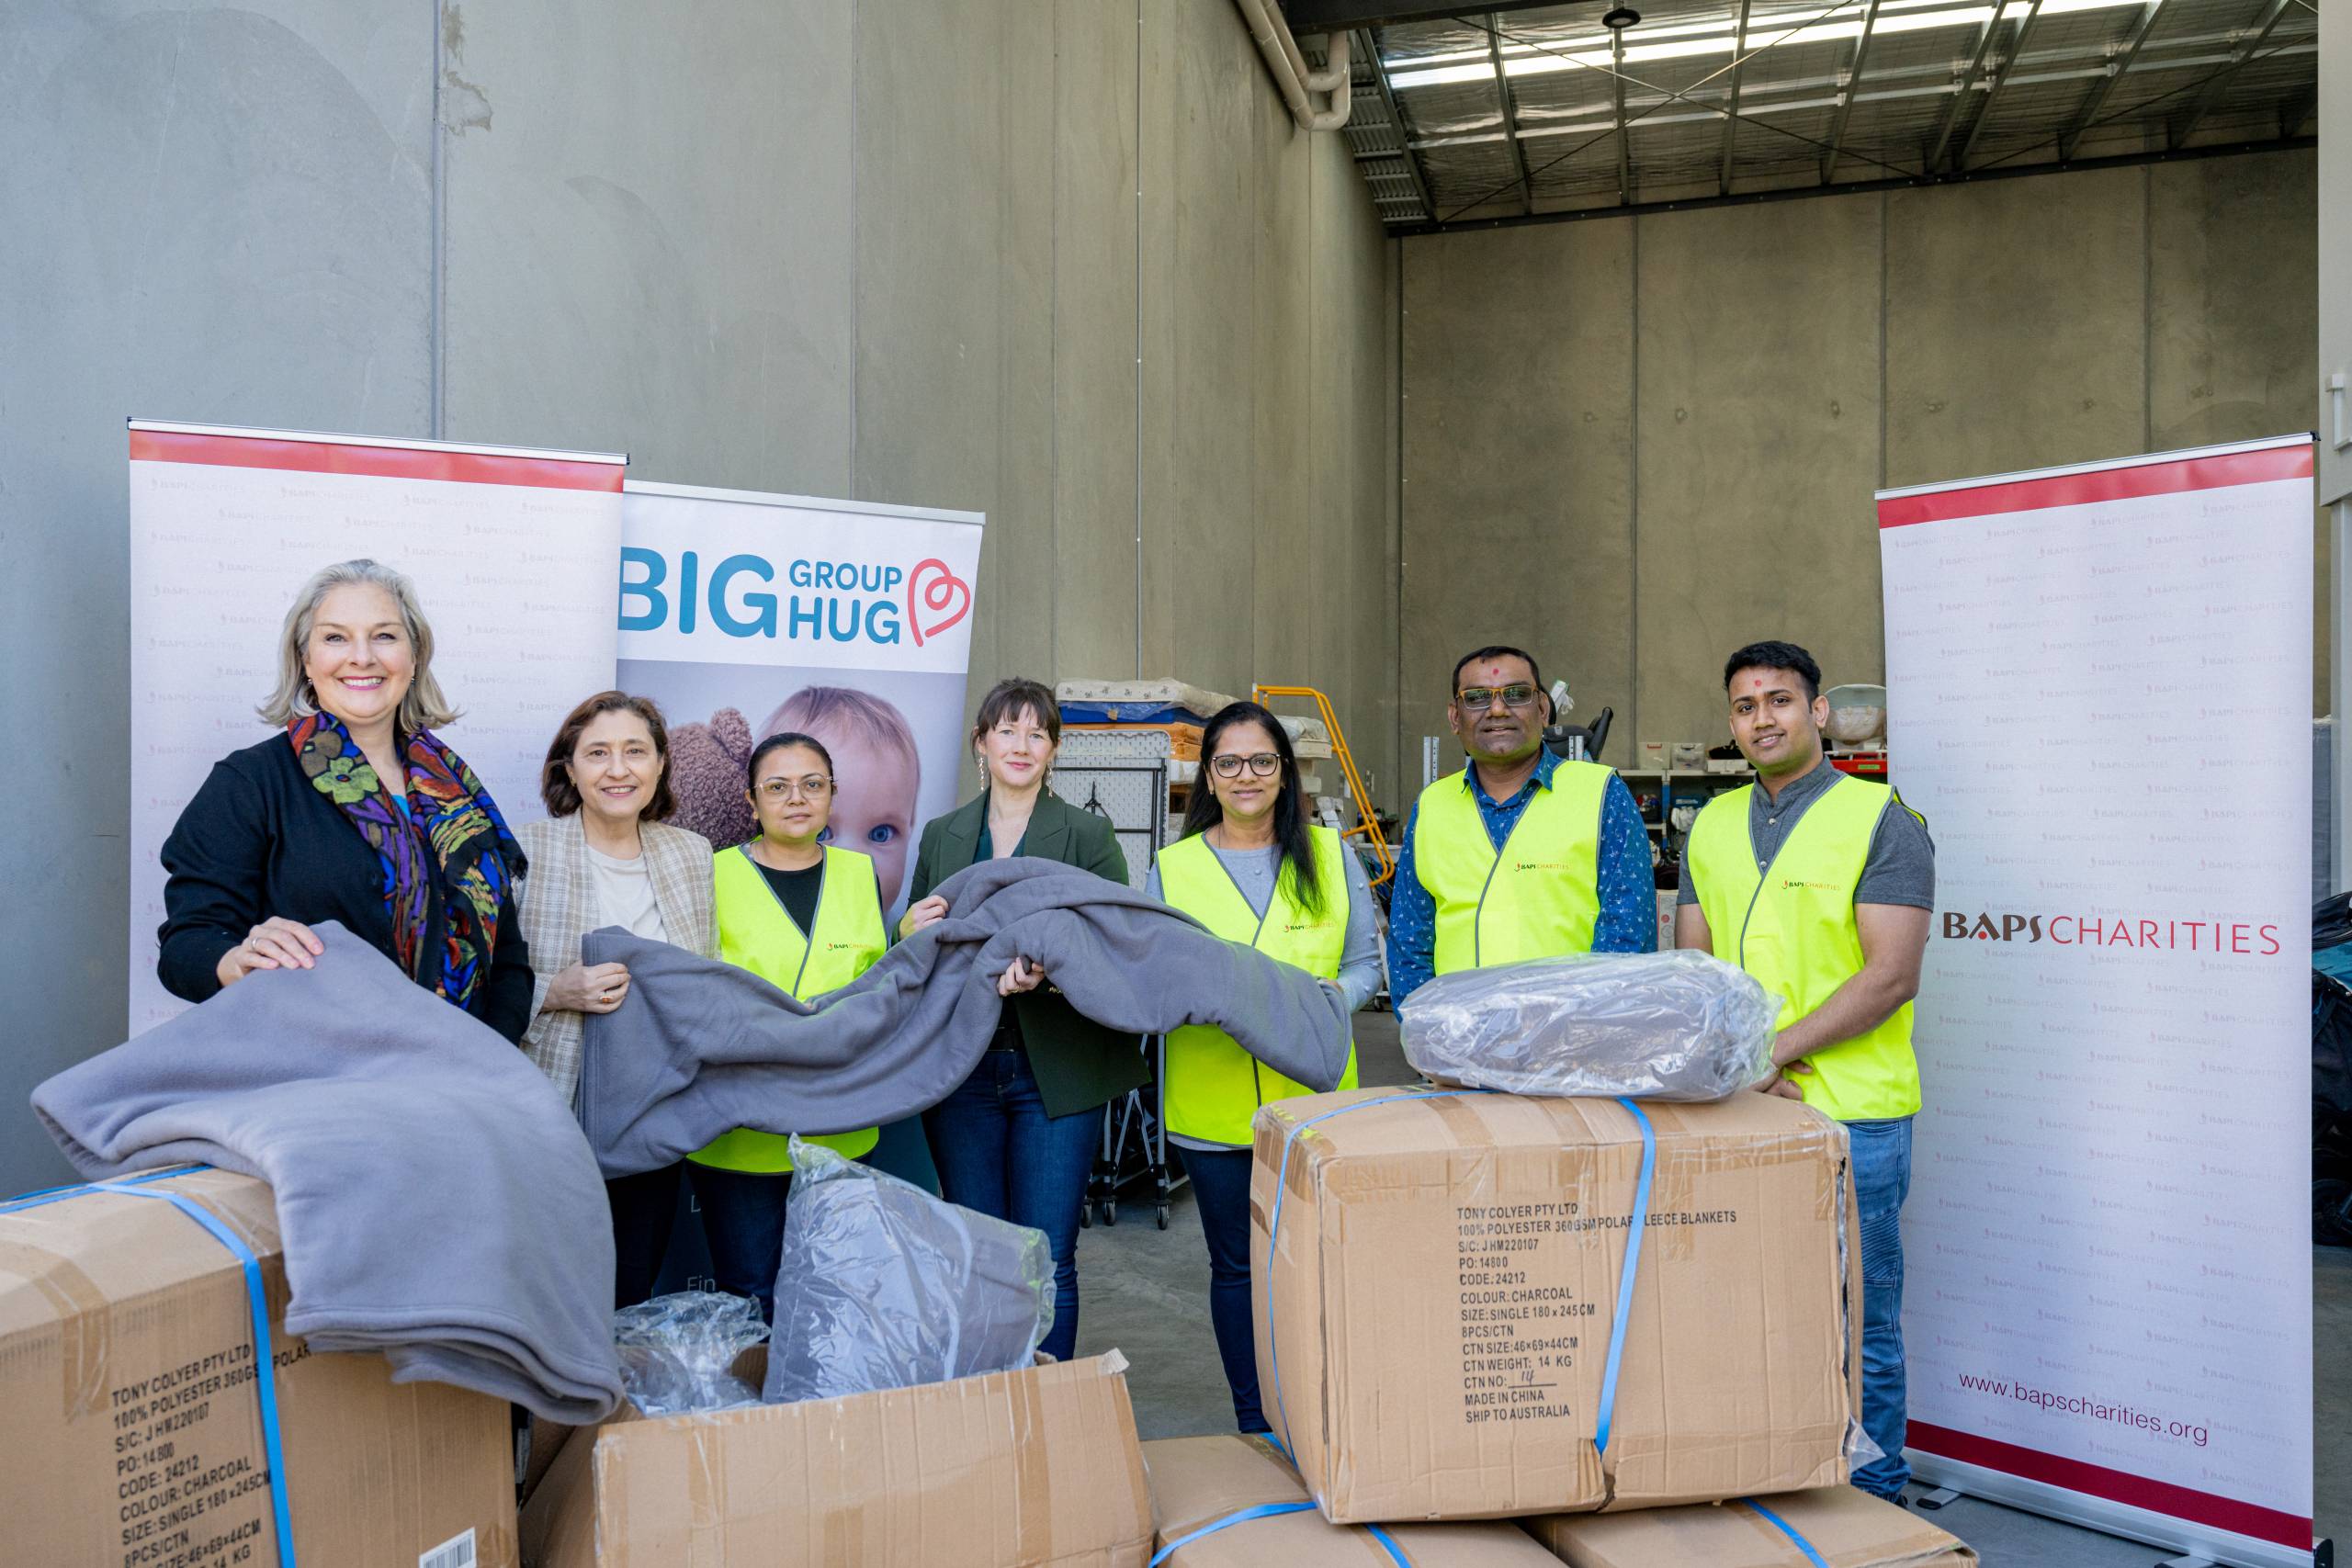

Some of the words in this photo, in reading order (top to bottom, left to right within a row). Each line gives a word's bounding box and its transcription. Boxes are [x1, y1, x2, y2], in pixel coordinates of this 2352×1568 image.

[789, 558, 902, 592] GROUP
[617, 546, 778, 638] BIG
[788, 595, 899, 645] HUG
[1457, 1207, 1486, 1220] TONY
[1488, 1205, 1532, 1219] COLYER
[1535, 1203, 1556, 1216] PTY
[1558, 1202, 1578, 1215] LTD
[1458, 1224, 1485, 1236] 100%
[1487, 1221, 1551, 1235] POLYESTER
[1644, 1213, 1678, 1226] LEECE
[1681, 1211, 1736, 1224] BLANKETS
[1532, 1305, 1550, 1317] 180
[1462, 1325, 1514, 1337] 8PCS/CTN
[1463, 1344, 1484, 1355] CTN
[1464, 1360, 1485, 1372] CTN
[1487, 1357, 1532, 1371] WEIGHT:
[1539, 1355, 1550, 1368] 14
[1556, 1355, 1572, 1367] KG
[112, 1381, 149, 1407] TONY
[152, 1362, 200, 1393] COLYER
[203, 1351, 225, 1372] PTY
[230, 1343, 250, 1363] LTD
[1464, 1377, 1485, 1389] CTN
[114, 1404, 148, 1430] 100%
[152, 1375, 220, 1416] POLYESTER
[1465, 1393, 1495, 1405] MADE
[1498, 1391, 1509, 1404] IN
[1511, 1390, 1544, 1403] CHINA
[1466, 1410, 1490, 1423] SHIP
[1493, 1408, 1507, 1420] TO
[1510, 1404, 1570, 1419] AUSTRALIA
[1958, 1373, 2209, 1448] www.bapscharities.org
[232, 1543, 251, 1564] KG
